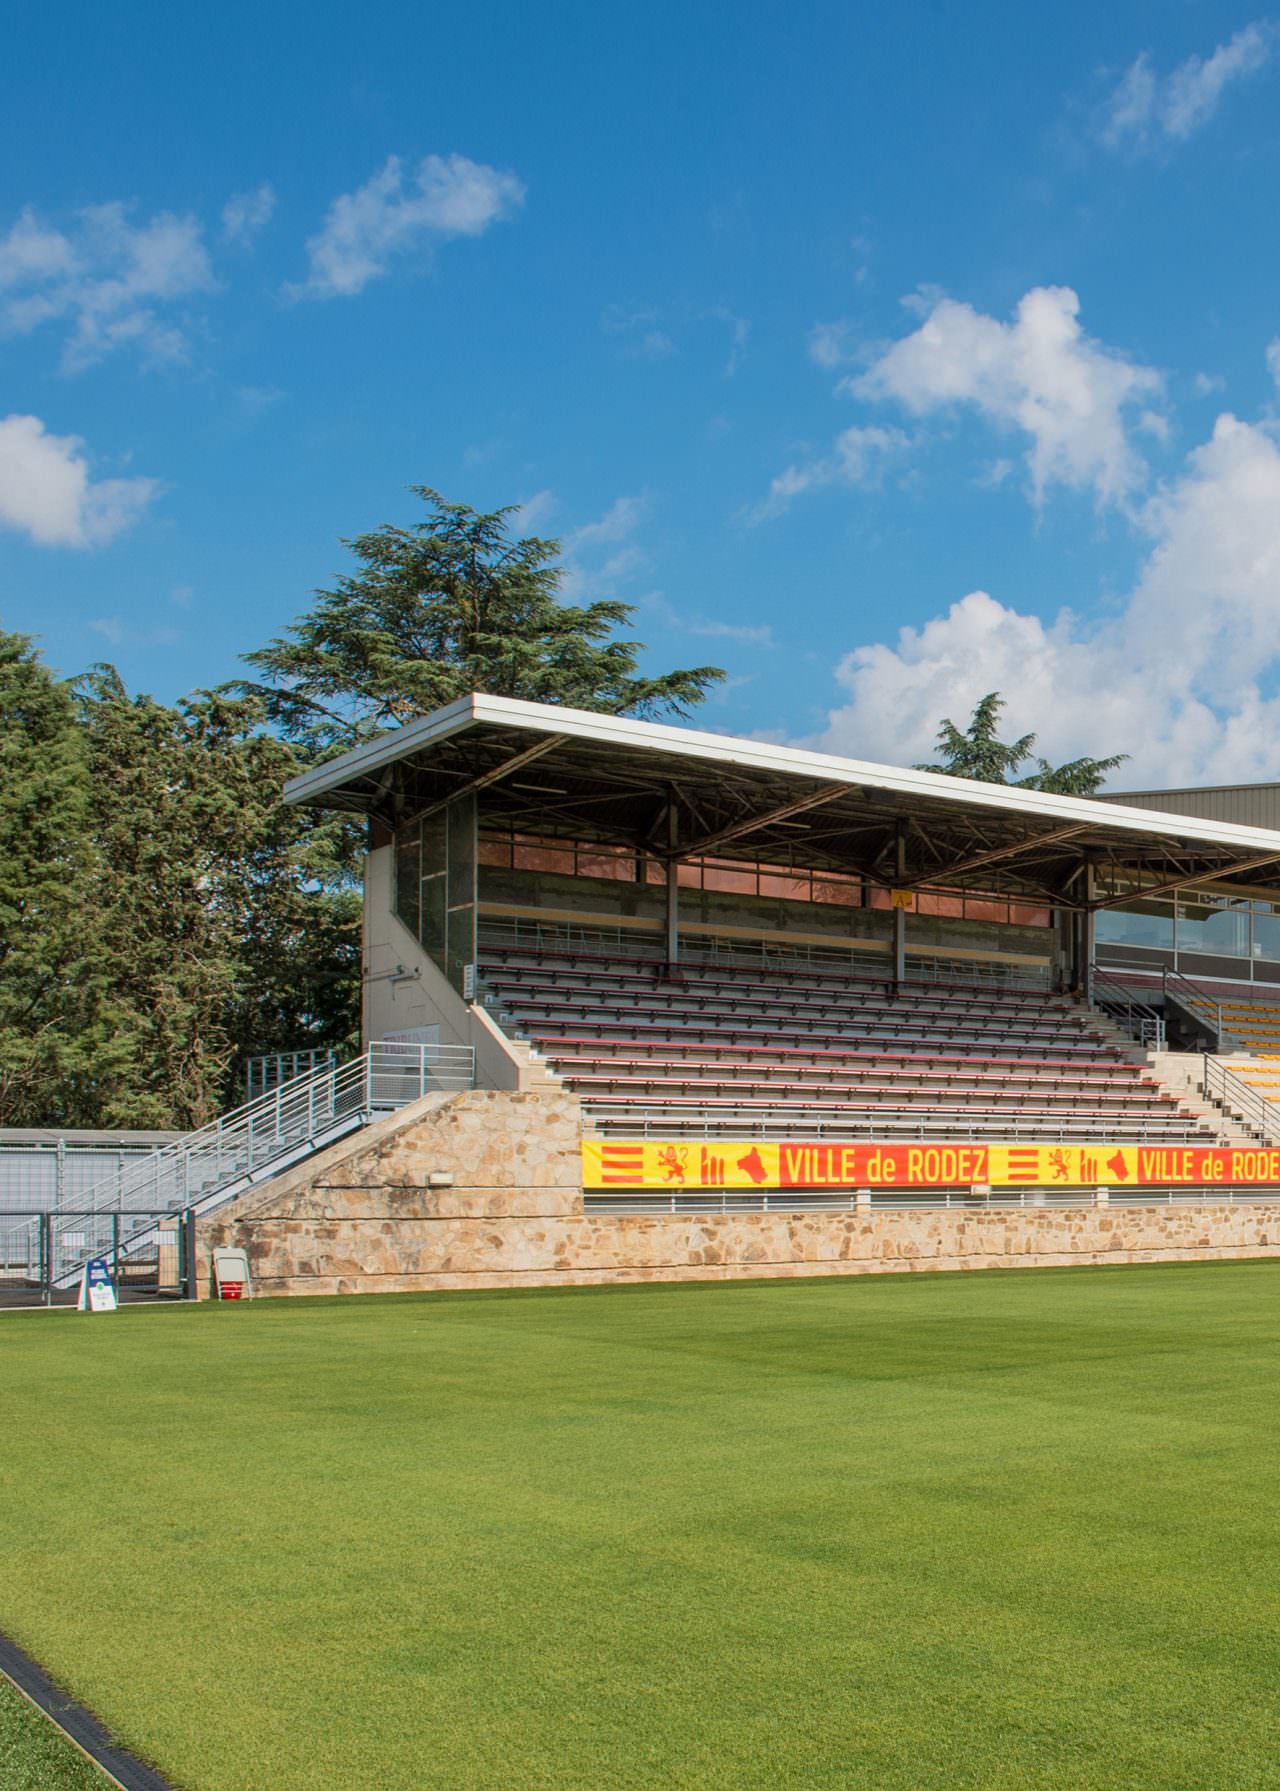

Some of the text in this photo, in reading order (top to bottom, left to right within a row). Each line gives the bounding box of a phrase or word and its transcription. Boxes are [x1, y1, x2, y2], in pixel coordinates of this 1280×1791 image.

[785, 1148, 986, 1183] VILLE de RODEZ
[1142, 1150, 1193, 1180] VILLE
[1201, 1151, 1223, 1180] de
